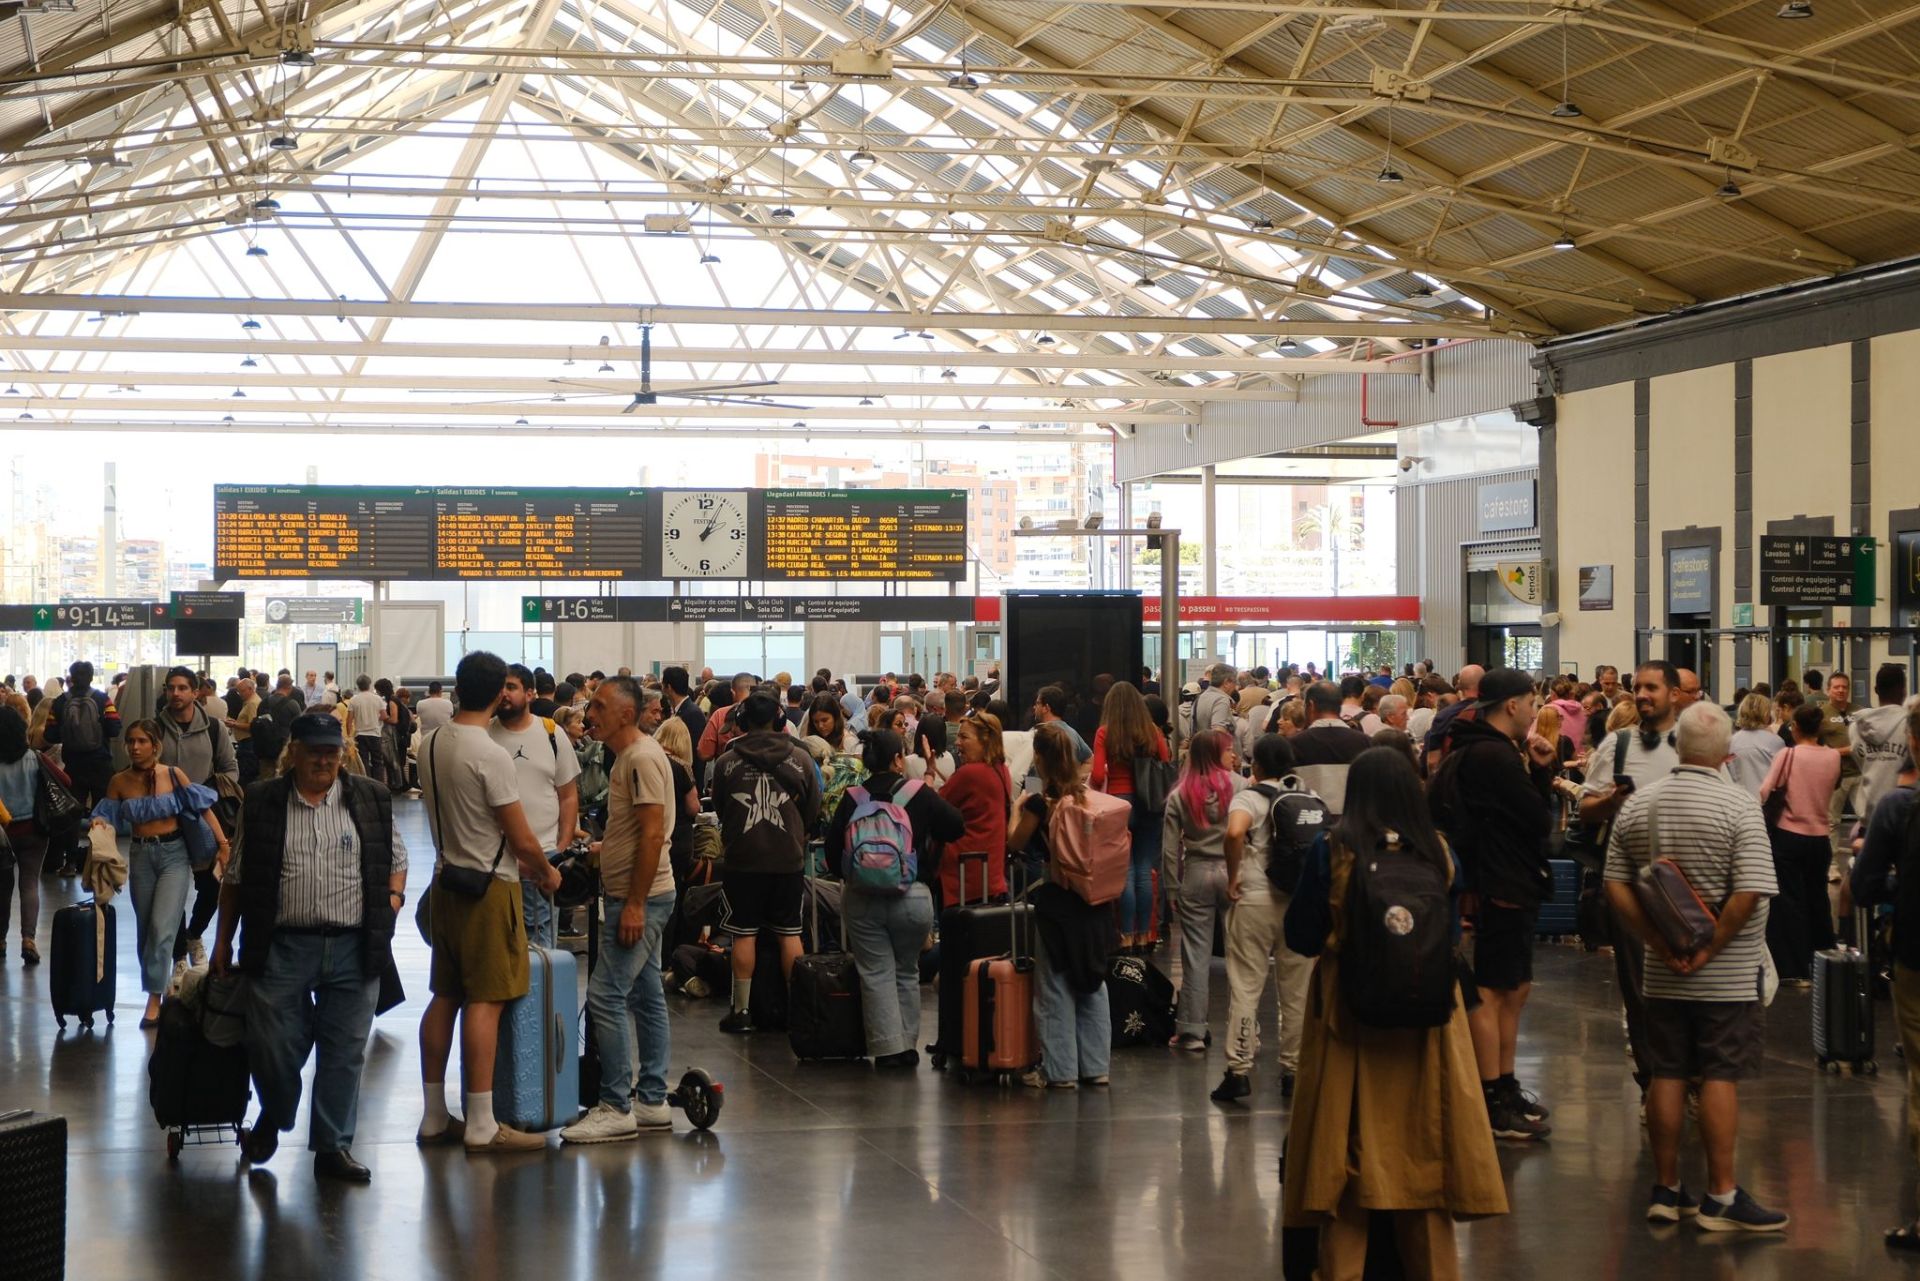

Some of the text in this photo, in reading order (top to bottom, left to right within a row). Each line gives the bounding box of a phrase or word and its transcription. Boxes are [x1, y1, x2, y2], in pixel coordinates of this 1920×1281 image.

[697, 499, 714, 509] 12
[1484, 497, 1529, 518] cafestore
[670, 529, 740, 539] 9 3
[700, 560, 710, 570] 6
[1806, 576, 1836, 584] equipajes
[1188, 606, 1216, 614] passeu
[1296, 810, 1323, 825] NB
